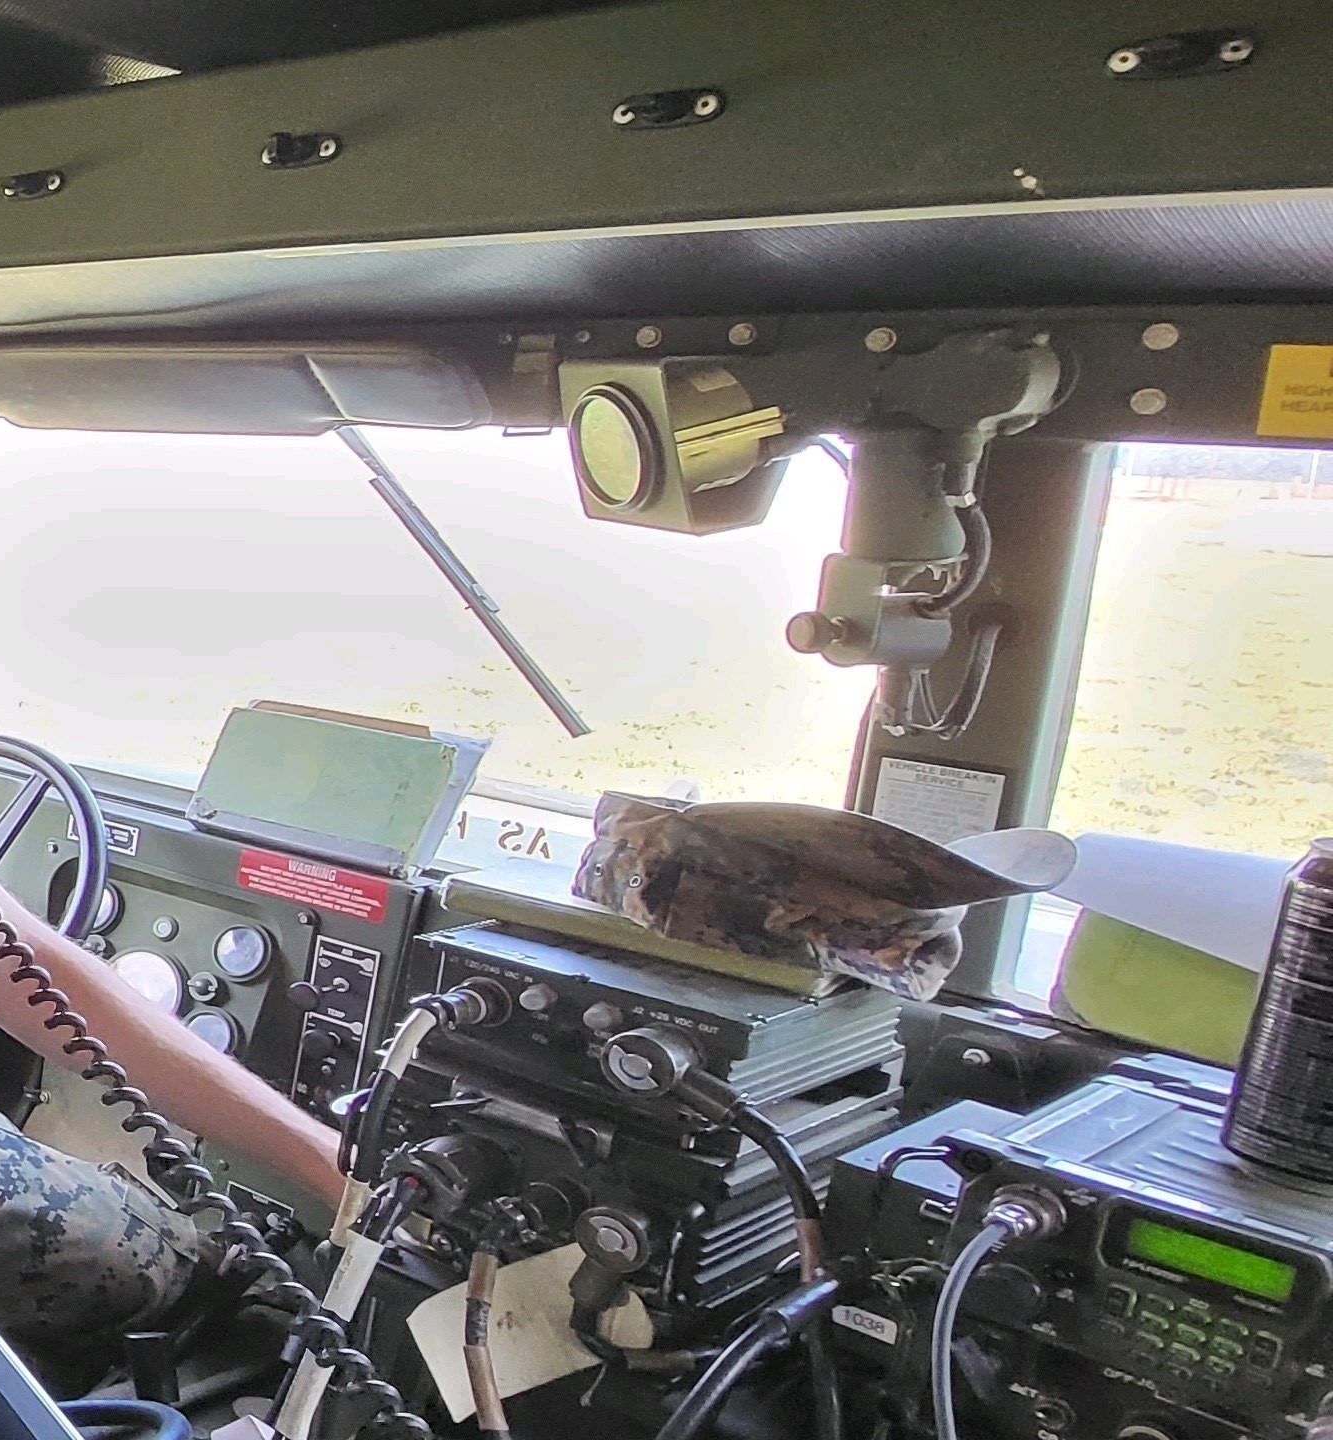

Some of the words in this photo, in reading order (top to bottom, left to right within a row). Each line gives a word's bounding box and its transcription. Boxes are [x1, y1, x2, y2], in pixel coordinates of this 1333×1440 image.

[888, 760, 936, 775] VEHICLE
[939, 765, 997, 784] BREAK-IN
[914, 774, 966, 786] SERVICE
[288, 859, 336, 882] WARNING
[698, 1023, 720, 1035] OUT
